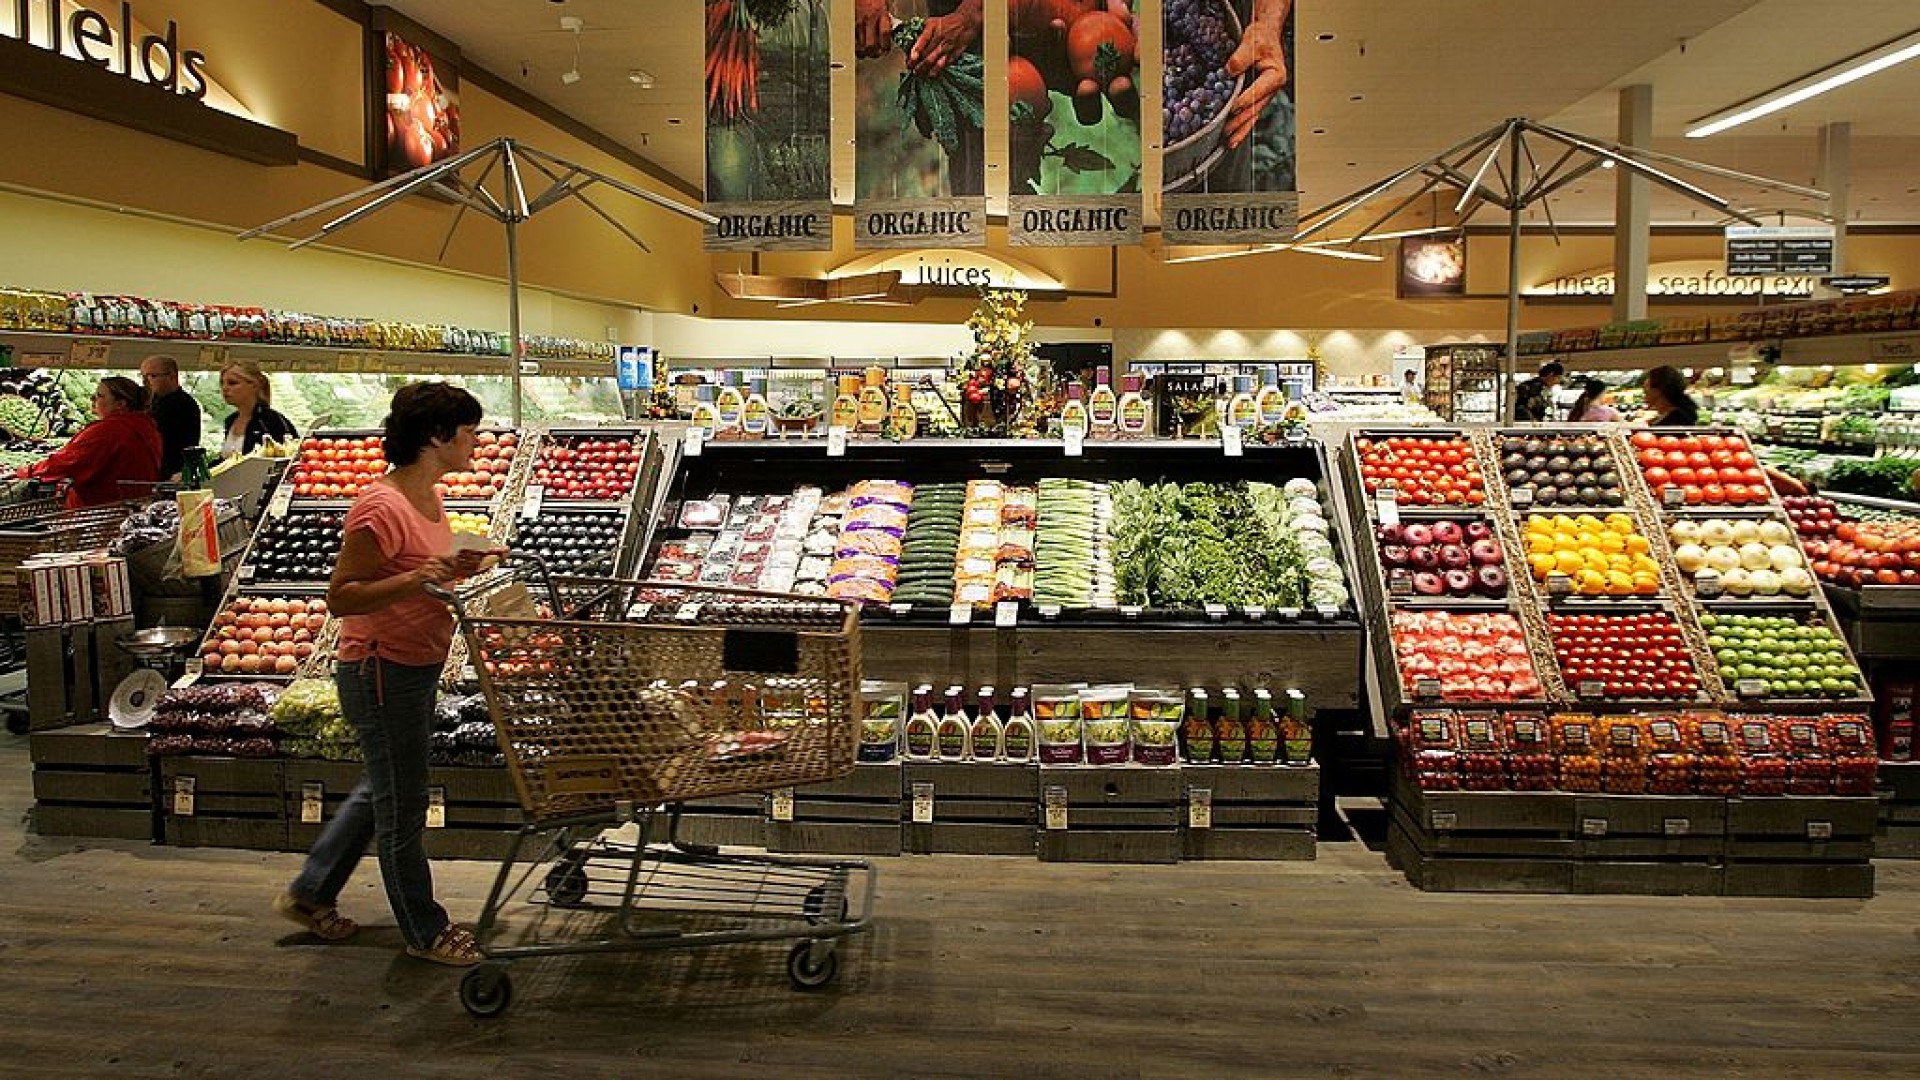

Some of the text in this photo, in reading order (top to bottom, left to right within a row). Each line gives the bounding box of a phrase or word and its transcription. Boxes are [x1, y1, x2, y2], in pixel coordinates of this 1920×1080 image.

[717, 213, 816, 238] ORGANIC
[867, 210, 970, 236] ORGANIC
[1022, 207, 1128, 233] ORGANIC
[1176, 206, 1284, 232] ORGANIC
[918, 256, 991, 287] juices
[1555, 275, 1615, 295] mea
